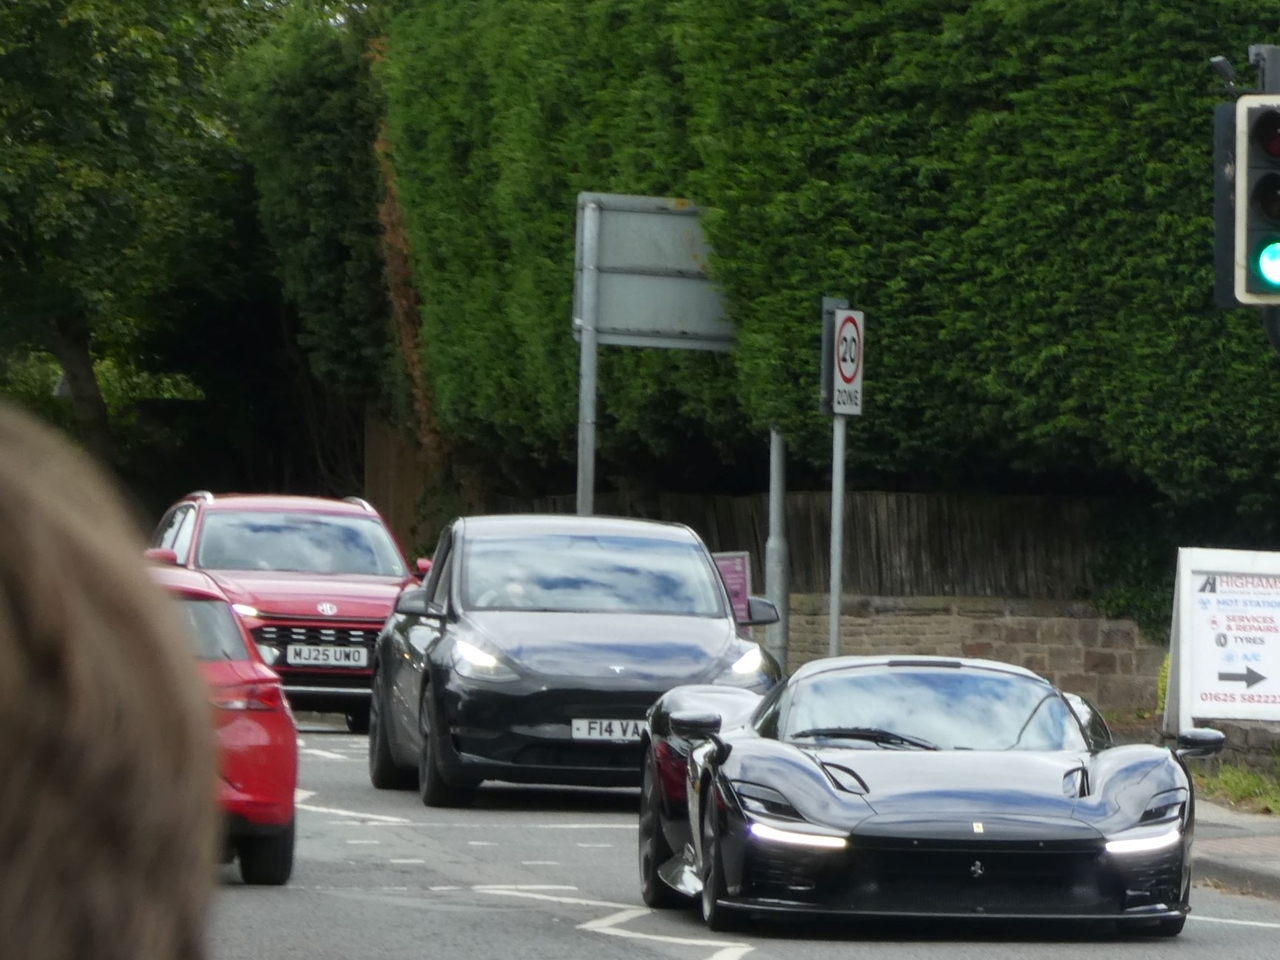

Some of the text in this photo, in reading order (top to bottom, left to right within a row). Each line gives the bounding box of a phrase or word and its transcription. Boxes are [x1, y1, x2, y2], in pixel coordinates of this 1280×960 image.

[841, 335, 857, 364] 20
[837, 389, 859, 406] ZONE
[1216, 598, 1238, 607] MOT
[1226, 615, 1275, 624] SERVICES
[1226, 624, 1279, 633] & REPAIRS
[1233, 636, 1266, 645] TYRES
[293, 647, 330, 661] MJ25
[1242, 653, 1261, 662] A/C
[1200, 692, 1237, 703] 01625
